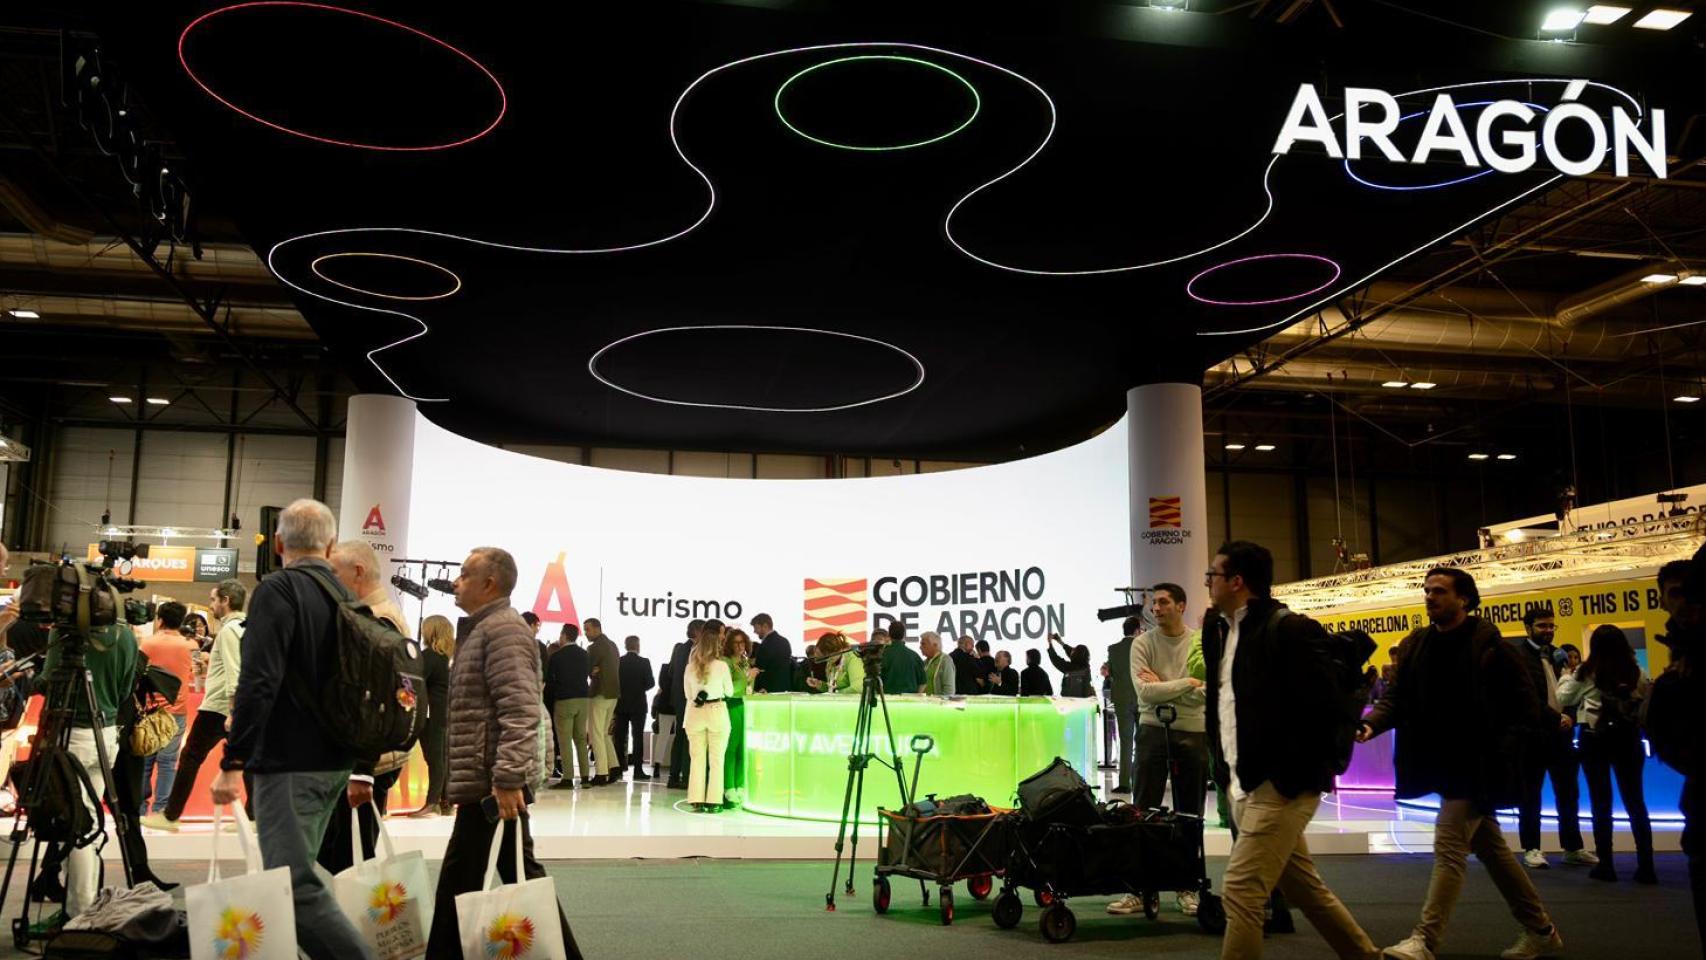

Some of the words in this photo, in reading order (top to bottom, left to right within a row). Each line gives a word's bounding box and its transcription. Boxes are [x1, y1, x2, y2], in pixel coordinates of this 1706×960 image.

[1272, 80, 1667, 180] ARAGÓN
[1141, 530, 1180, 540] GOBIERNO
[201, 565, 230, 573] unesco
[873, 566, 1045, 608] GOBIERNO
[617, 592, 743, 620] turismo
[1580, 592, 1617, 615] THIS
[1623, 590, 1640, 611] IS
[936, 603, 1065, 642] ARAGON
